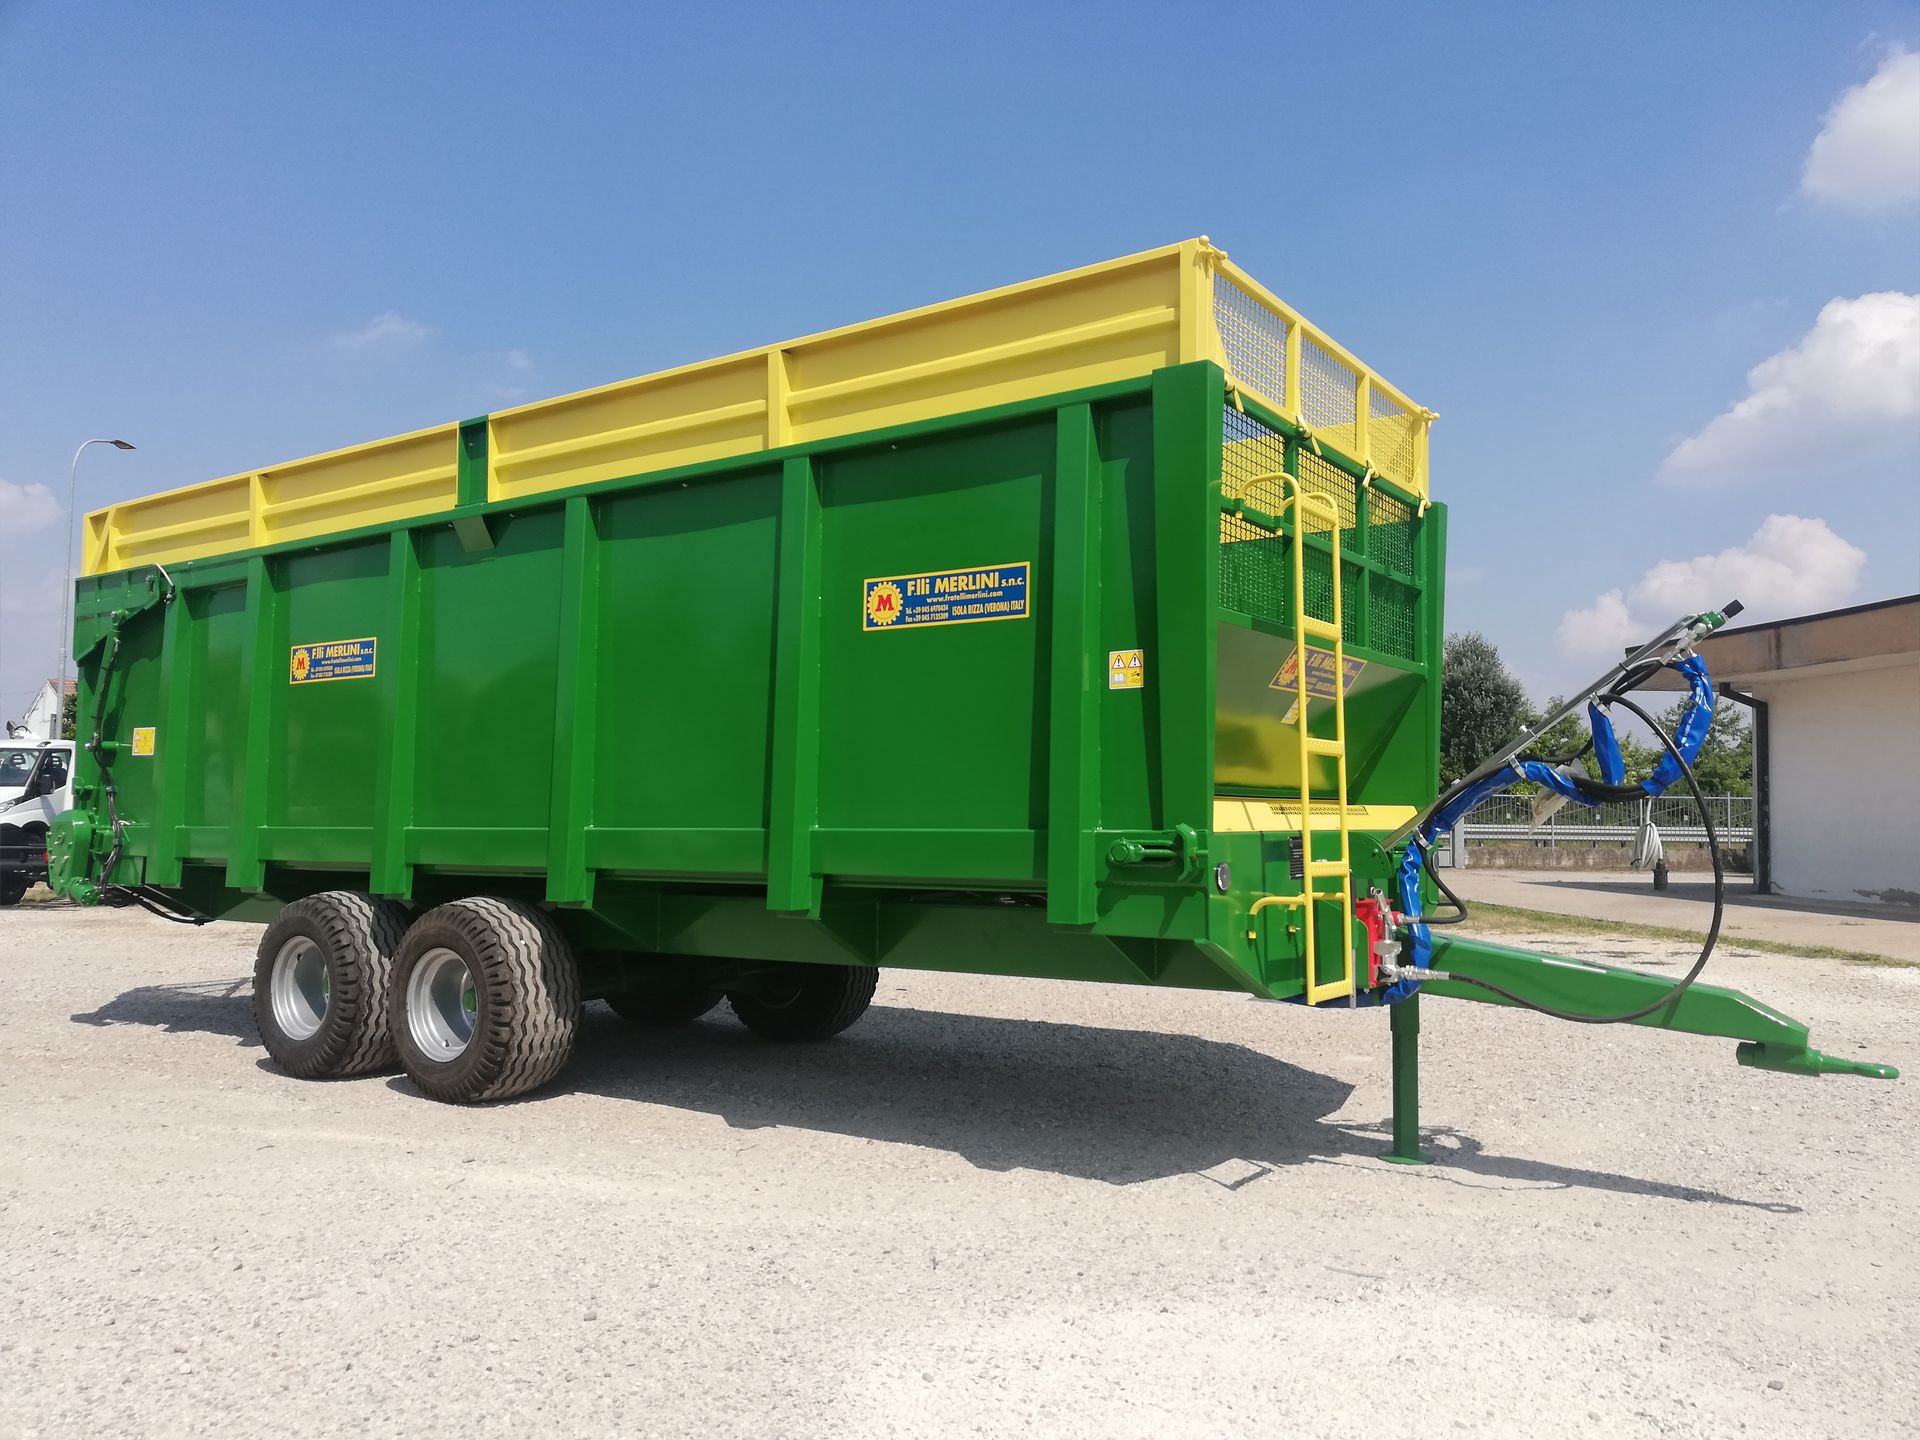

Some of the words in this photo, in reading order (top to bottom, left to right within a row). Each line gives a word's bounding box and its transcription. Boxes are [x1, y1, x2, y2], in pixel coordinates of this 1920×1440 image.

[907, 578, 930, 596] F.lli
[934, 572, 999, 594] MERLINI
[1001, 576, 1024, 587] s.n.c.
[875, 594, 894, 612] M
[926, 590, 1003, 603] www.fratellimerlini.com
[952, 605, 967, 616] ISOLA
[968, 603, 984, 614] RIZZA
[984, 601, 1010, 614] (VERONA)
[1010, 600, 1025, 611] ITALY
[326, 643, 360, 658] MERLINI
[296, 657, 305, 671] M
